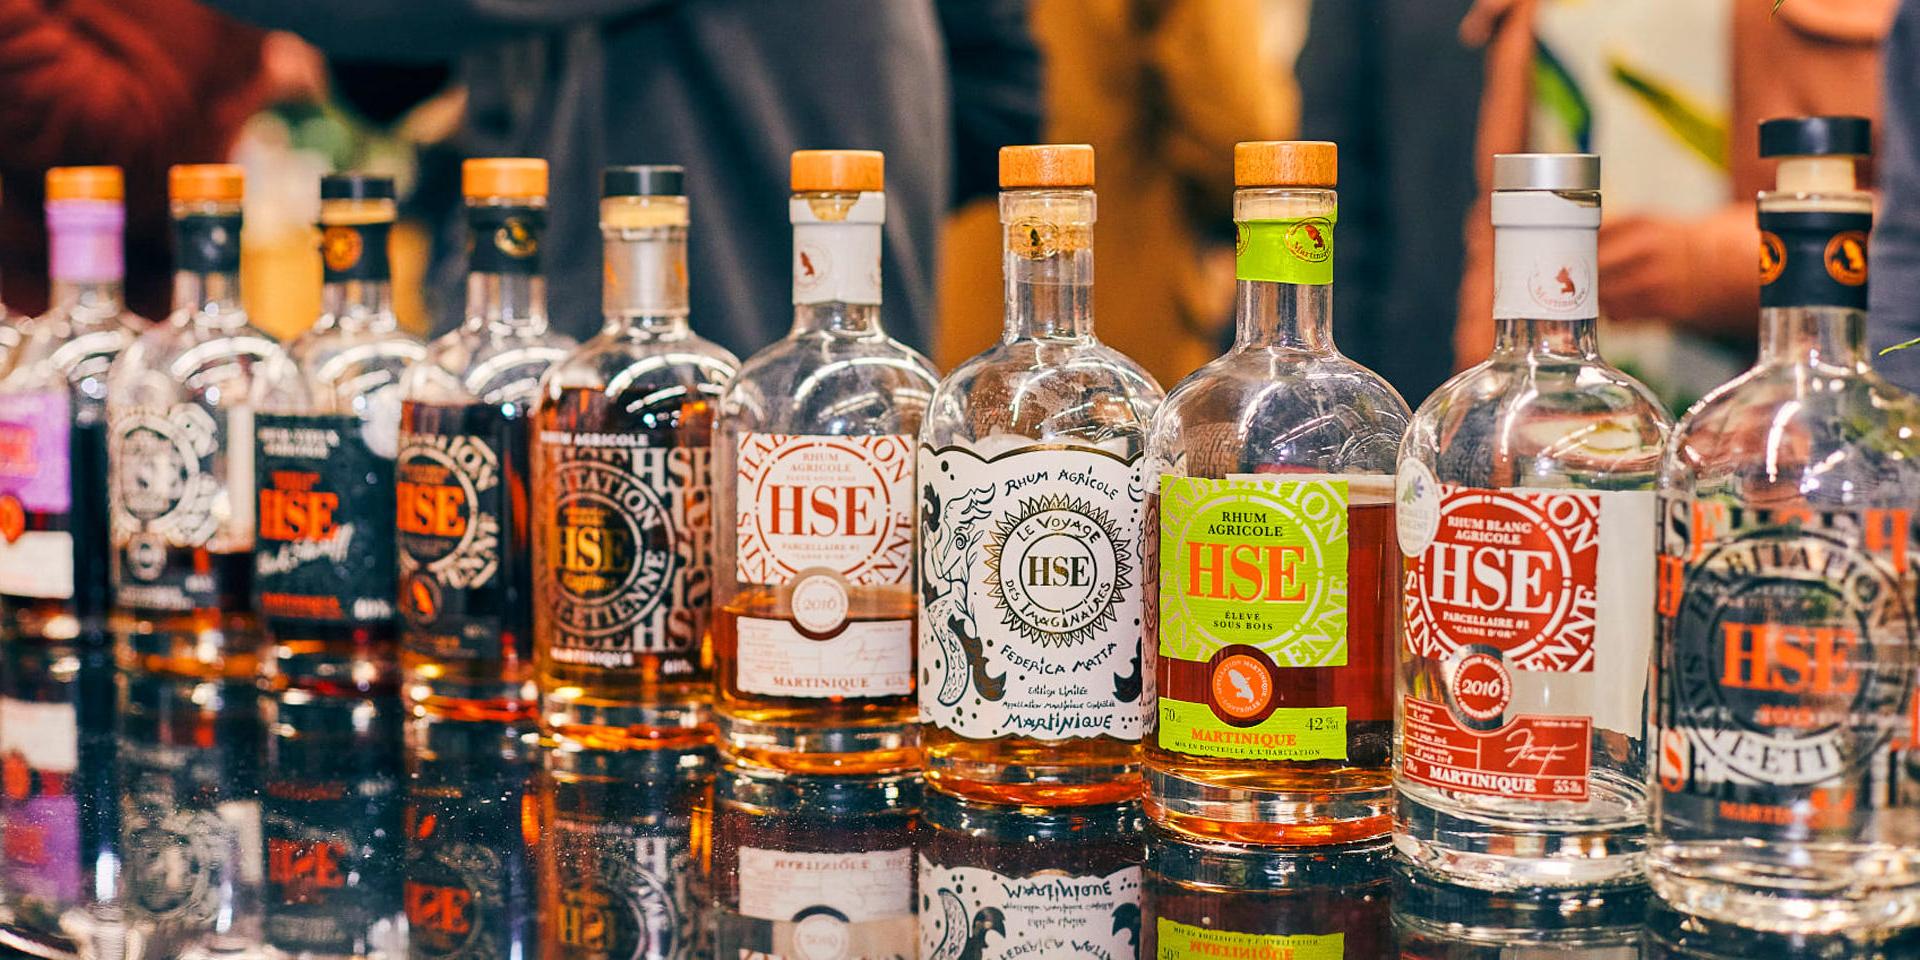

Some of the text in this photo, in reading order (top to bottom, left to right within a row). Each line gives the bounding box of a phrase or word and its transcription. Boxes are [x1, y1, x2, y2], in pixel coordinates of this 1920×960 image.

[803, 453, 838, 461] RHUM
[791, 464, 851, 472] AGRICOLE
[1005, 465, 1119, 500] RHUM AGRICOLE
[768, 485, 877, 538] HSE
[1222, 511, 1267, 524] RHUM
[1016, 515, 1101, 544] LE VOYAGE
[1208, 524, 1283, 537] AGRICOLE
[1448, 515, 1483, 532] RHUM
[1486, 518, 1533, 535] BLANC
[1455, 530, 1521, 546] AGRICOLE
[1027, 555, 1090, 587] HSE
[1187, 541, 1307, 603] HSE
[1429, 541, 1553, 614] HSE
[803, 597, 838, 610] 2016
[1005, 579, 1111, 628] DES IMAGINAIRES
[1213, 620, 1273, 631] SOUS BOIS
[1443, 611, 1513, 629] PARCELLAIRE
[1000, 642, 1117, 675] FEDERICA MATTA
[1721, 621, 1859, 696] HSE
[773, 677, 870, 693] MARTINIQUE
[1461, 677, 1501, 698] 2016
[1164, 708, 1175, 722] 70
[1305, 717, 1323, 731] 42
[1192, 728, 1297, 749] MARTINIQUE
[1199, 744, 1245, 755] BOUTEILLE
[1429, 765, 1537, 796] MARTINIQUE
